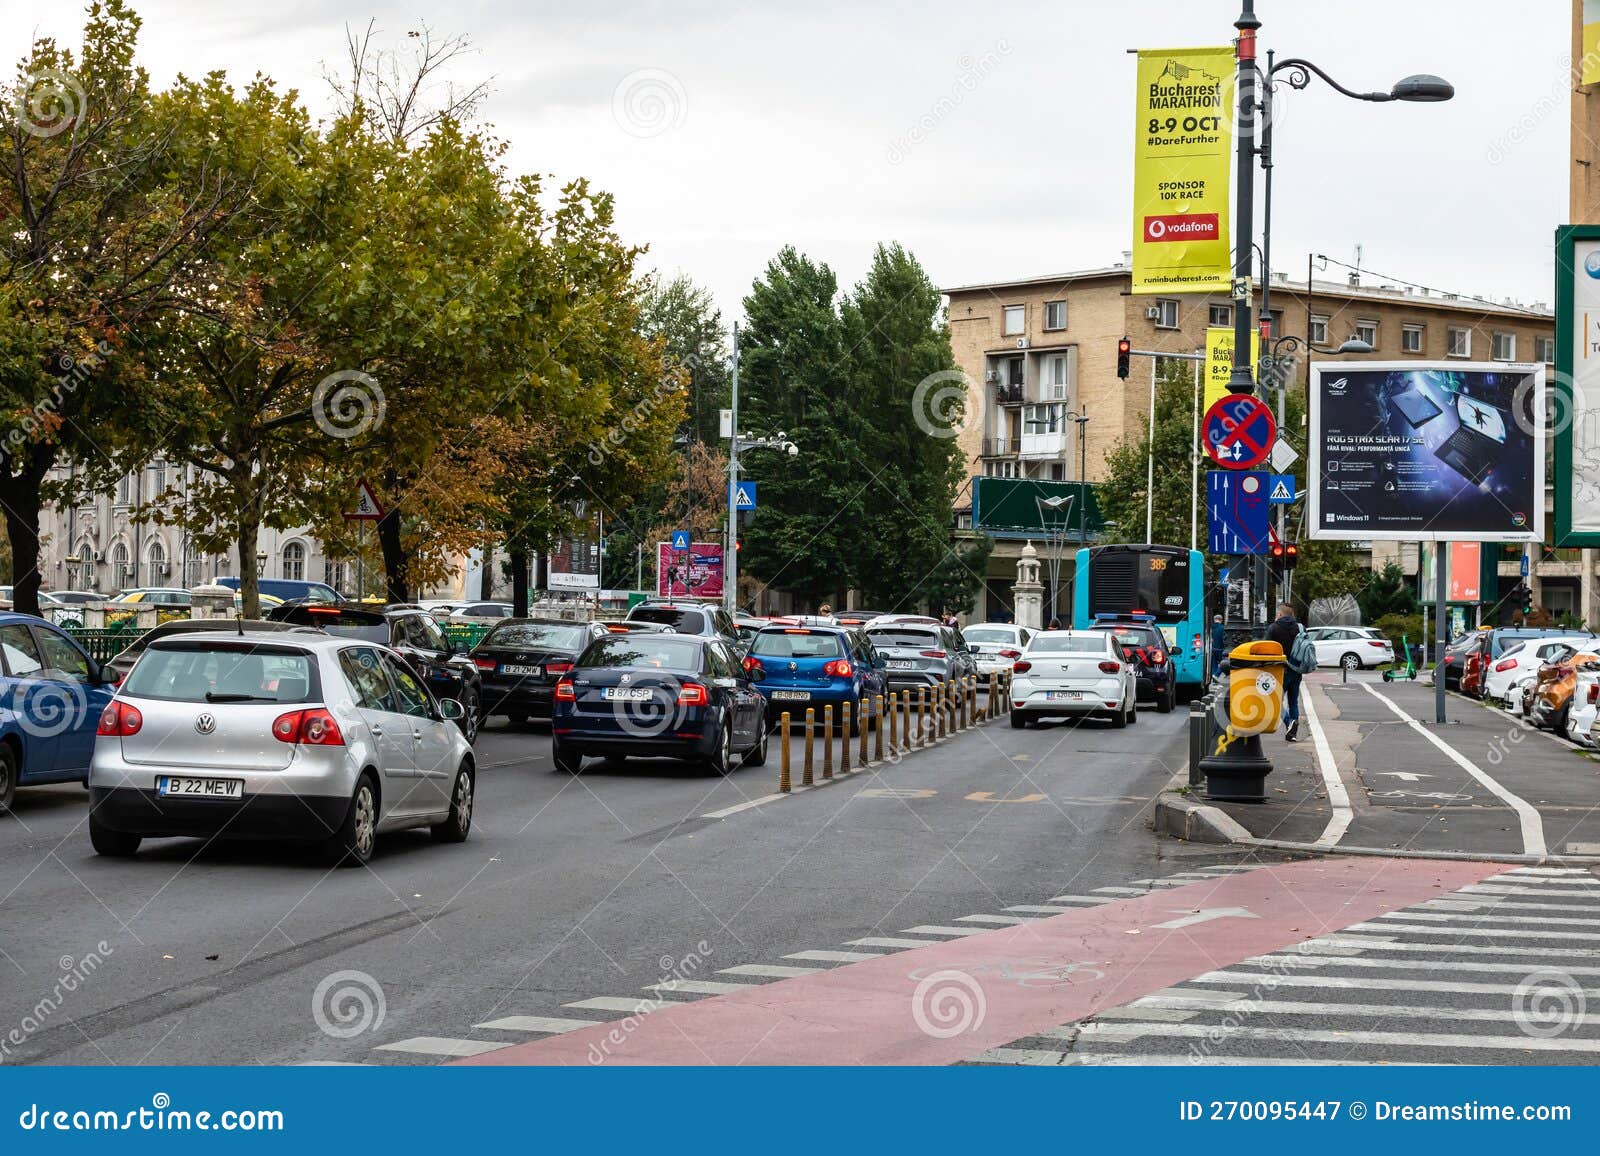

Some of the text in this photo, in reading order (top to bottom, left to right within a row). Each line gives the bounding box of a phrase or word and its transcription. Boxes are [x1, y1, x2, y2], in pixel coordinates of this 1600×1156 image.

[1150, 82, 1221, 97] Bucharest
[1150, 95, 1221, 109] MARATHON
[1148, 116, 1221, 133] 8-9 OCT
[1147, 135, 1219, 146] #DareFurther
[1158, 180, 1205, 191] SPONSOR
[1160, 190, 1203, 200] 10K RACE
[1167, 221, 1214, 233] vodafone
[1144, 274, 1220, 284] runinbucharest.com
[1212, 365, 1228, 374] 8-9
[1150, 559, 1166, 570] 385
[607, 688, 649, 698] B 87 CSP
[170, 779, 237, 795] B 22 MEW
